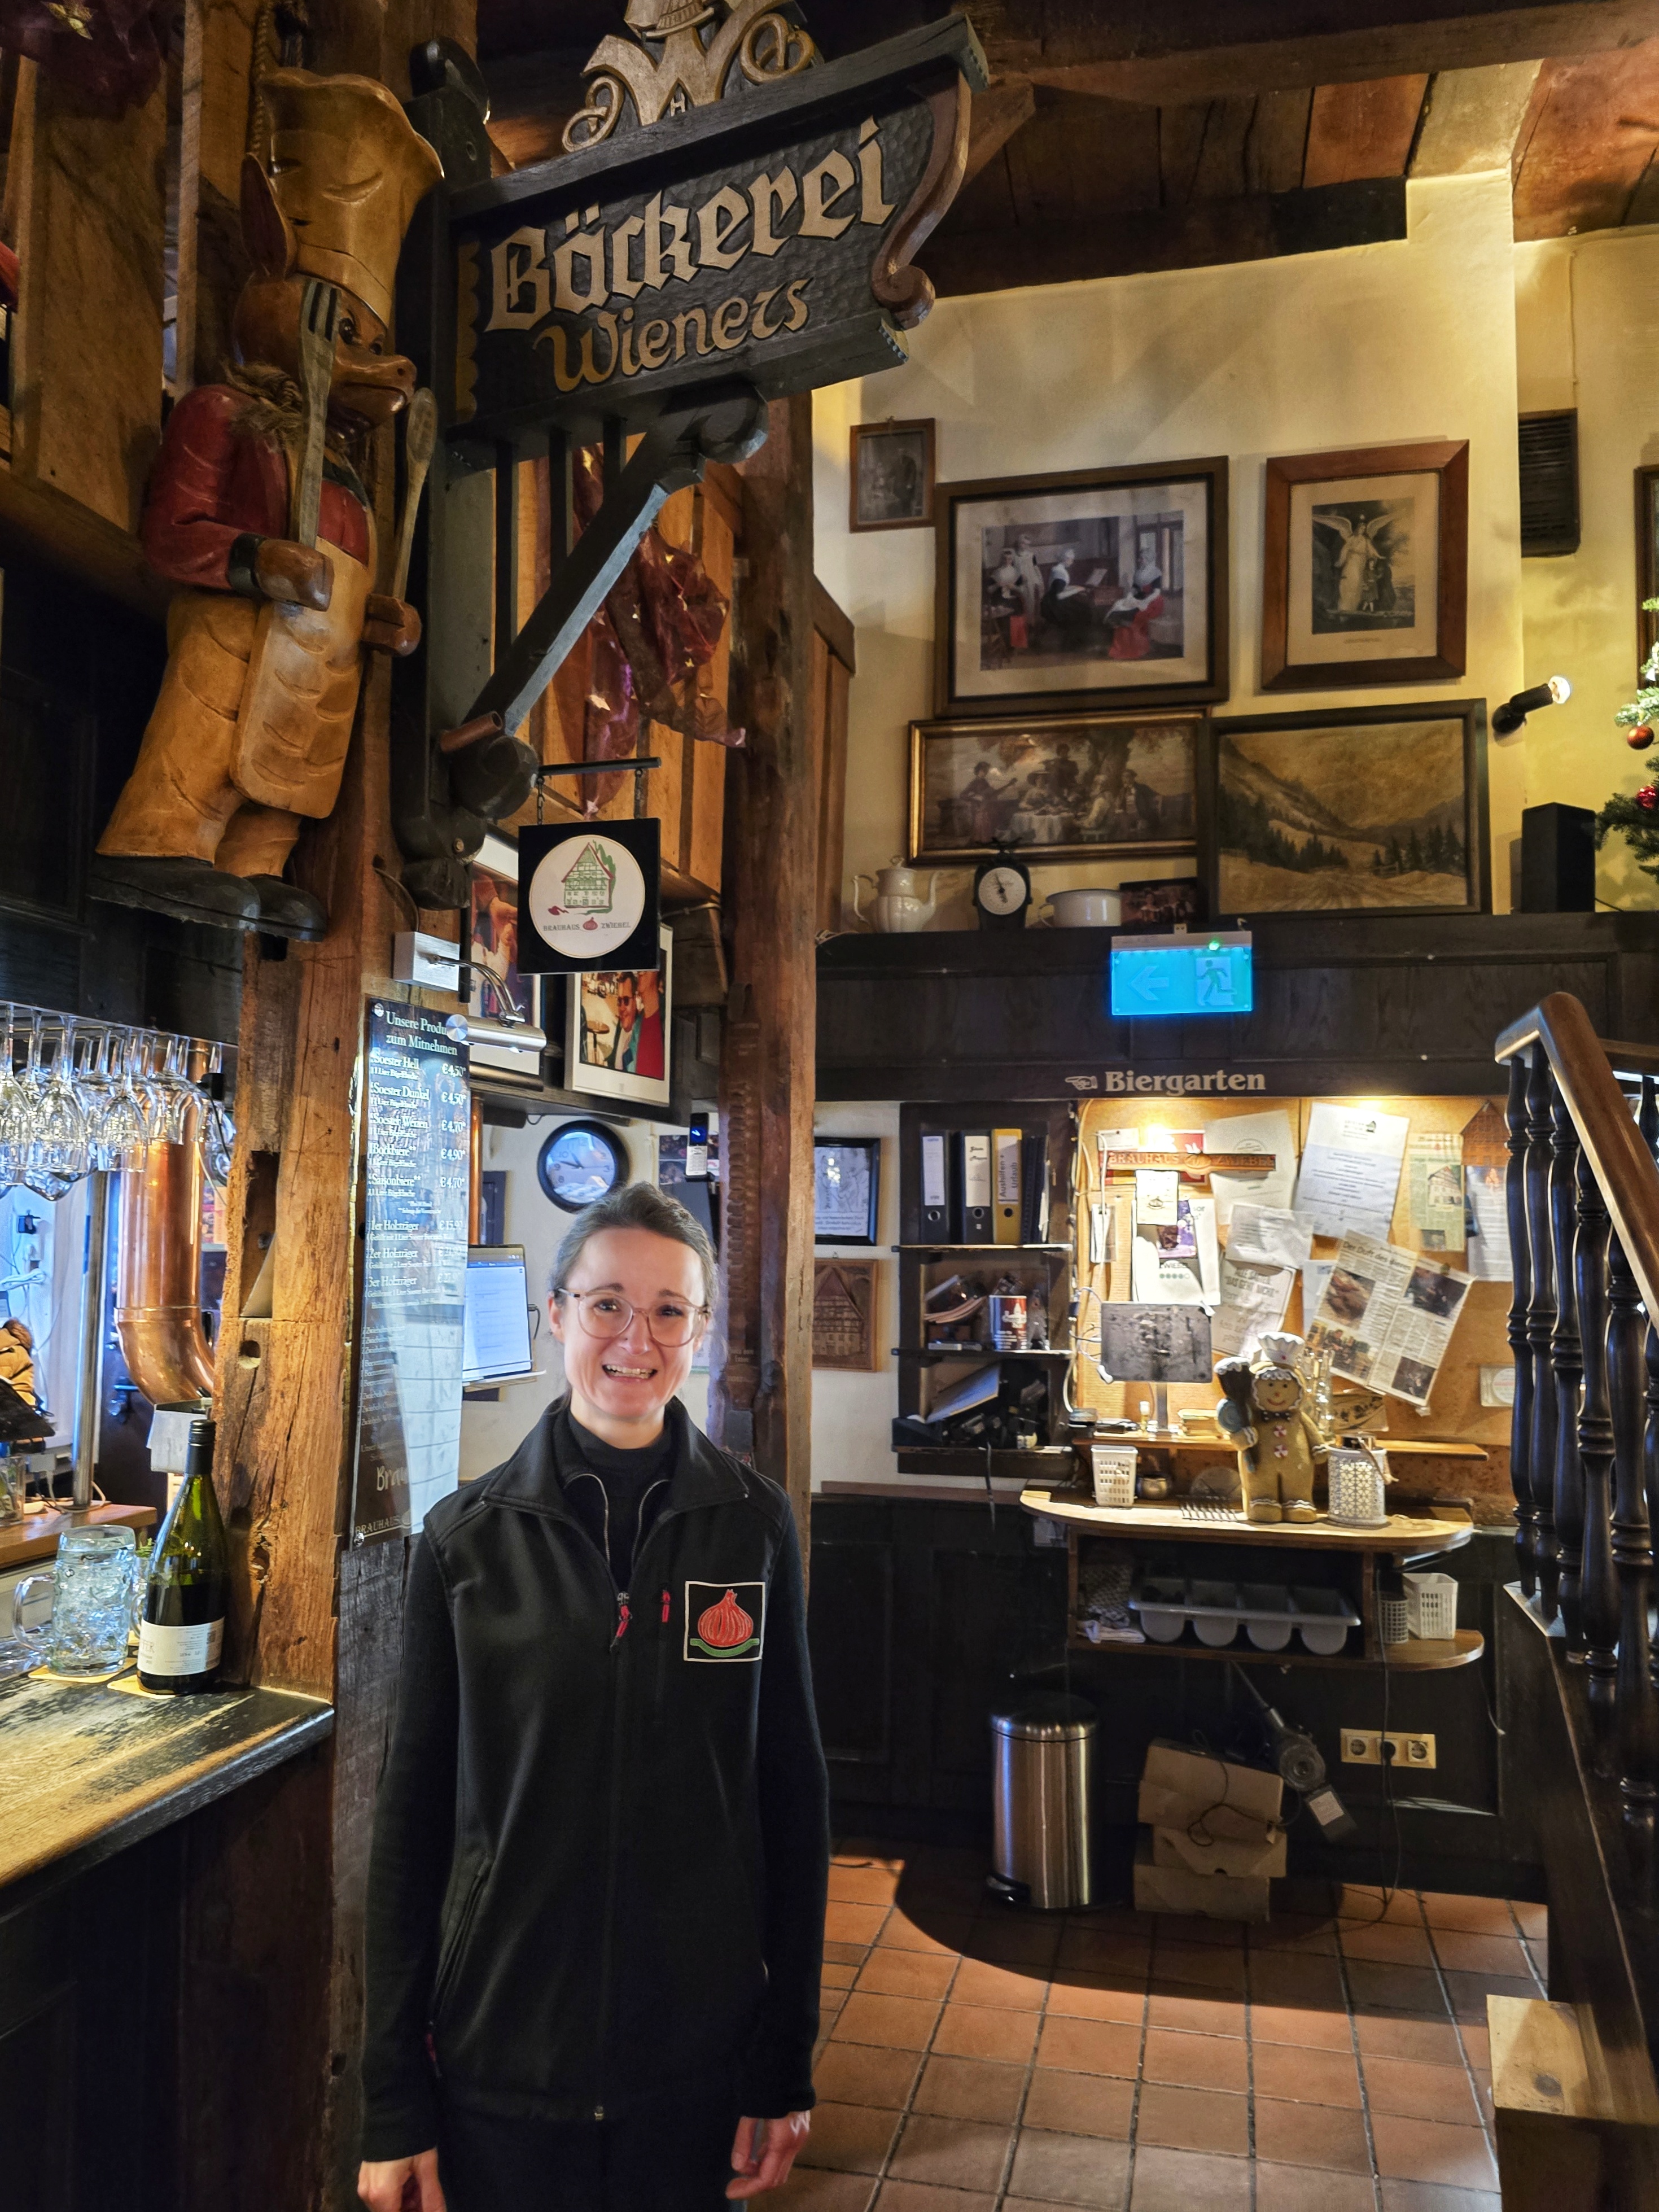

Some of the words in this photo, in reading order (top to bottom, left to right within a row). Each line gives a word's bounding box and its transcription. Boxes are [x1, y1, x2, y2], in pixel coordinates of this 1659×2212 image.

[386, 1010, 419, 1029] Unsere
[420, 1018, 448, 1035] Produ
[386, 1035, 406, 1046] zum
[408, 1034, 458, 1055] Mitnehmen
[401, 1085, 430, 1101] Dunkel
[1104, 1069, 1266, 1097] Biergarten
